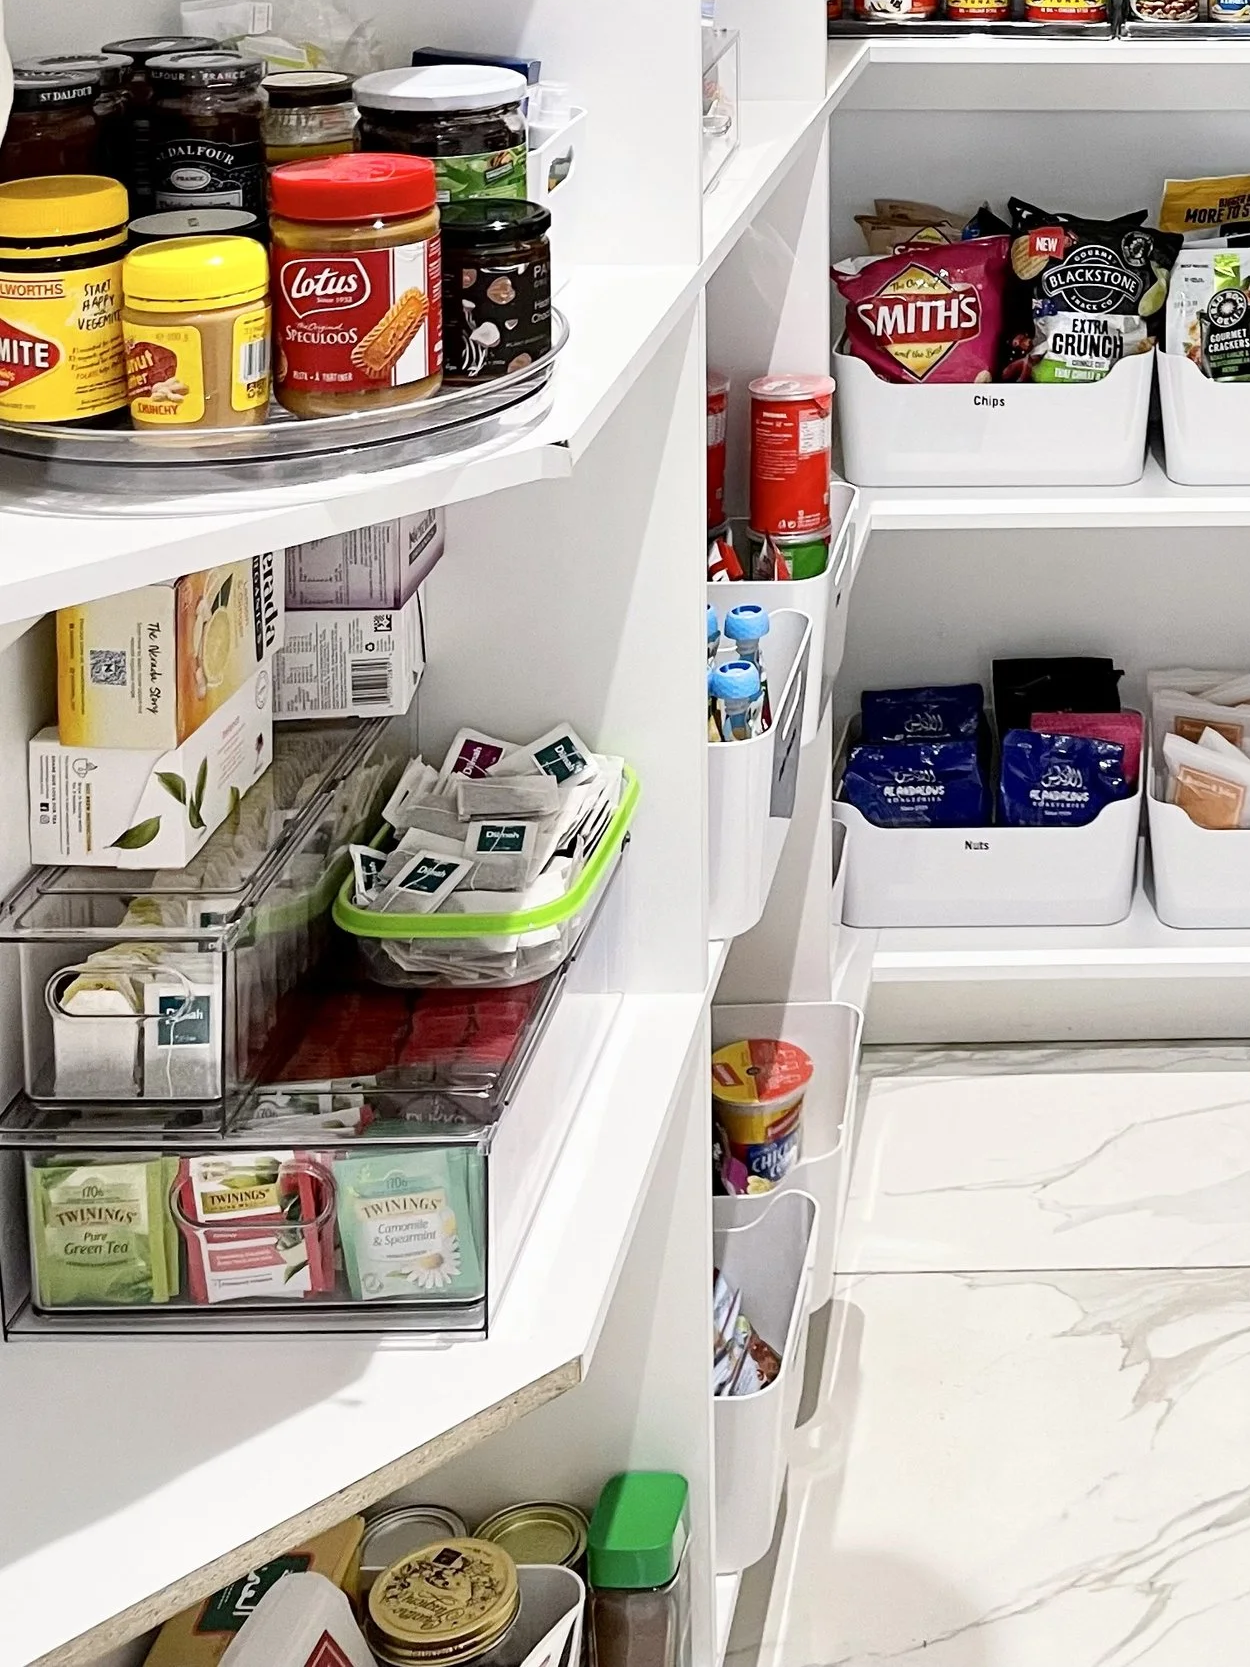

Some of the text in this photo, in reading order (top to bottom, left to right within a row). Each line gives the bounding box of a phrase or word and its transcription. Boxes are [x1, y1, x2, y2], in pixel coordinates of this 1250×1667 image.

[168, 145, 235, 166] DALFOUR
[1183, 206, 1224, 224] MORE
[1226, 203, 1242, 221] TO
[1035, 236, 1059, 253] NEW
[84, 278, 112, 297] START
[291, 266, 358, 299] Lotus
[1048, 268, 1137, 294] BLACKSTONE
[82, 294, 116, 312] HAPPY
[857, 294, 978, 337] SMITH'S
[1216, 313, 1241, 326] DELI
[285, 324, 359, 345] SPECULOOS
[1071, 318, 1109, 335] EXTRA
[1209, 327, 1248, 344] GOURMET
[0, 337, 49, 369] MITE
[1051, 332, 1125, 360] CRUNCH
[137, 402, 179, 416] CRUNCHY
[973, 394, 1006, 408] Chips
[262, 551, 279, 648] erada
[146, 622, 160, 641] The
[145, 682, 162, 717] Story
[485, 829, 521, 840] Dilmah
[964, 839, 991, 851] Nuts
[209, 1188, 267, 1206] TWININGS
[55, 1205, 134, 1227] TWININGS
[361, 1197, 438, 1219] TWININGS
[378, 1218, 429, 1235] Camomile
[83, 1231, 109, 1242] Pure
[372, 1229, 437, 1247] & Spearmint
[64, 1241, 129, 1256] Green Tea
